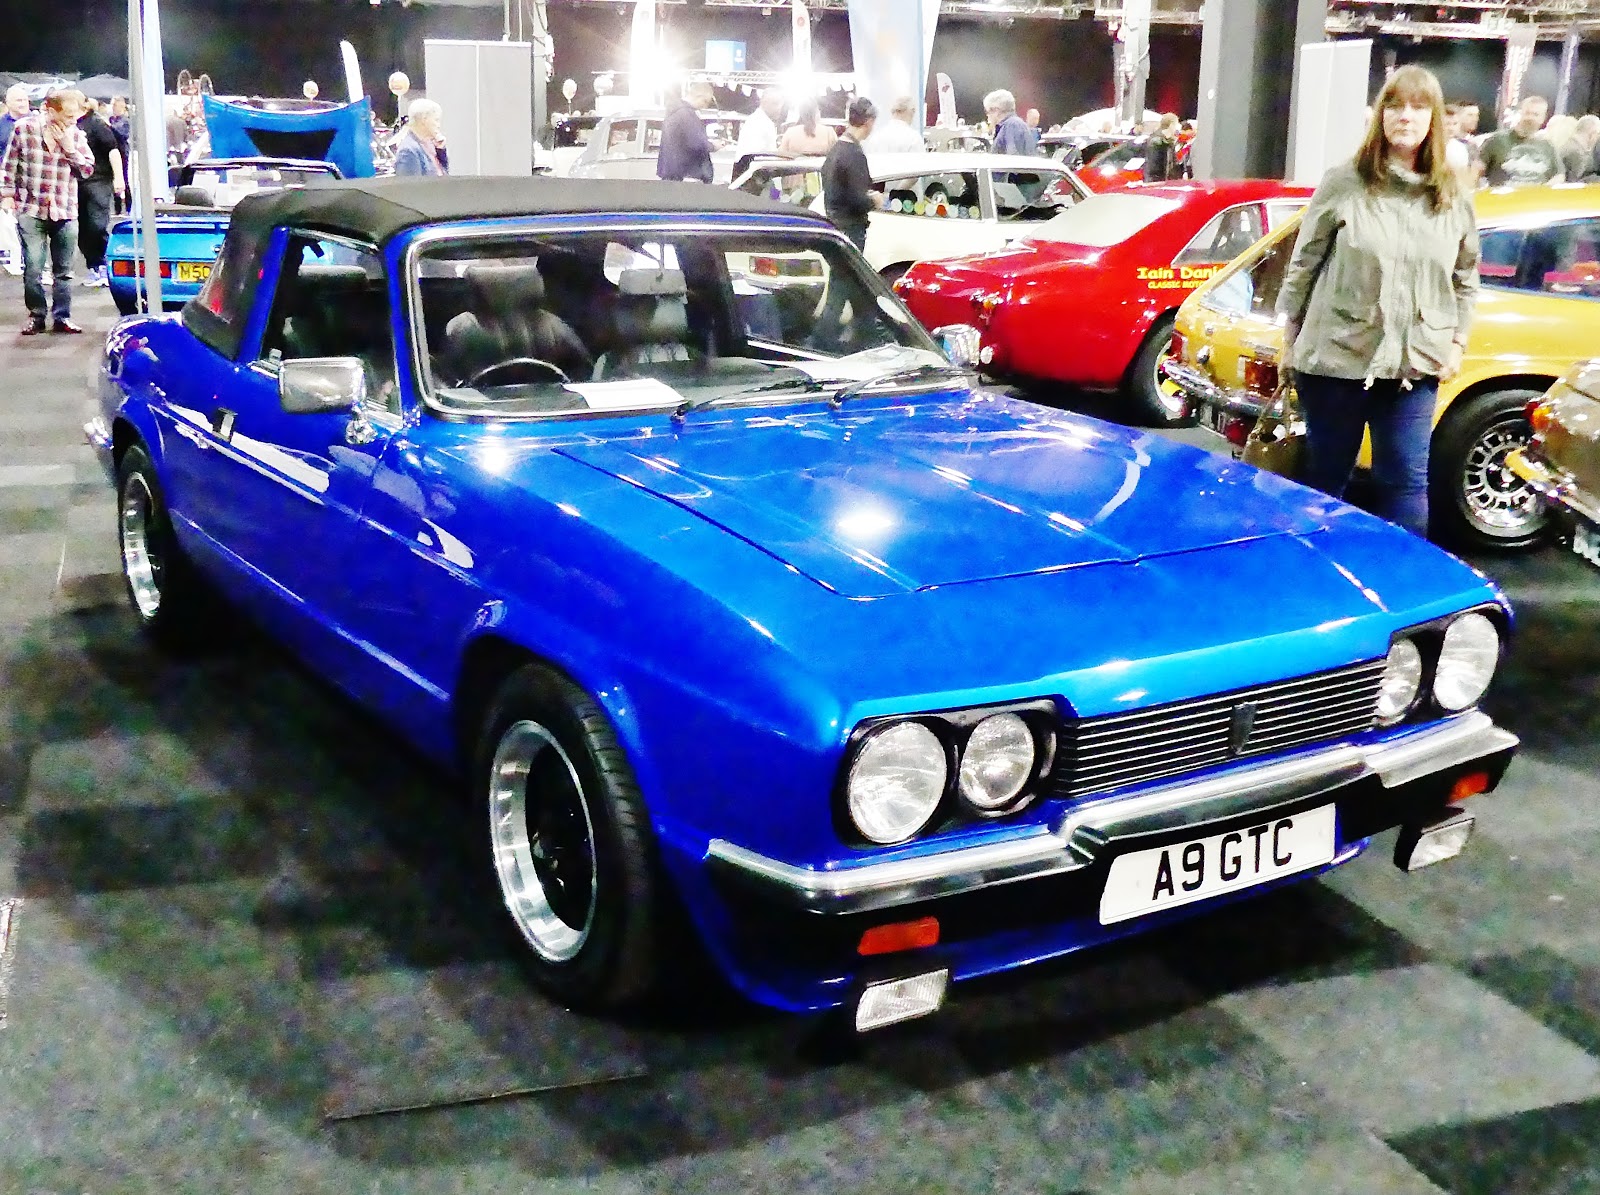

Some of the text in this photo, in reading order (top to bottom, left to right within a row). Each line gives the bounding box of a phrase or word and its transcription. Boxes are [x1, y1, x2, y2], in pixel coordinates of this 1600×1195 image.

[1136, 266, 1221, 280] Iain Dani
[1147, 281, 1181, 289] CLASSIC
[1152, 818, 1294, 901] A9 GTC
